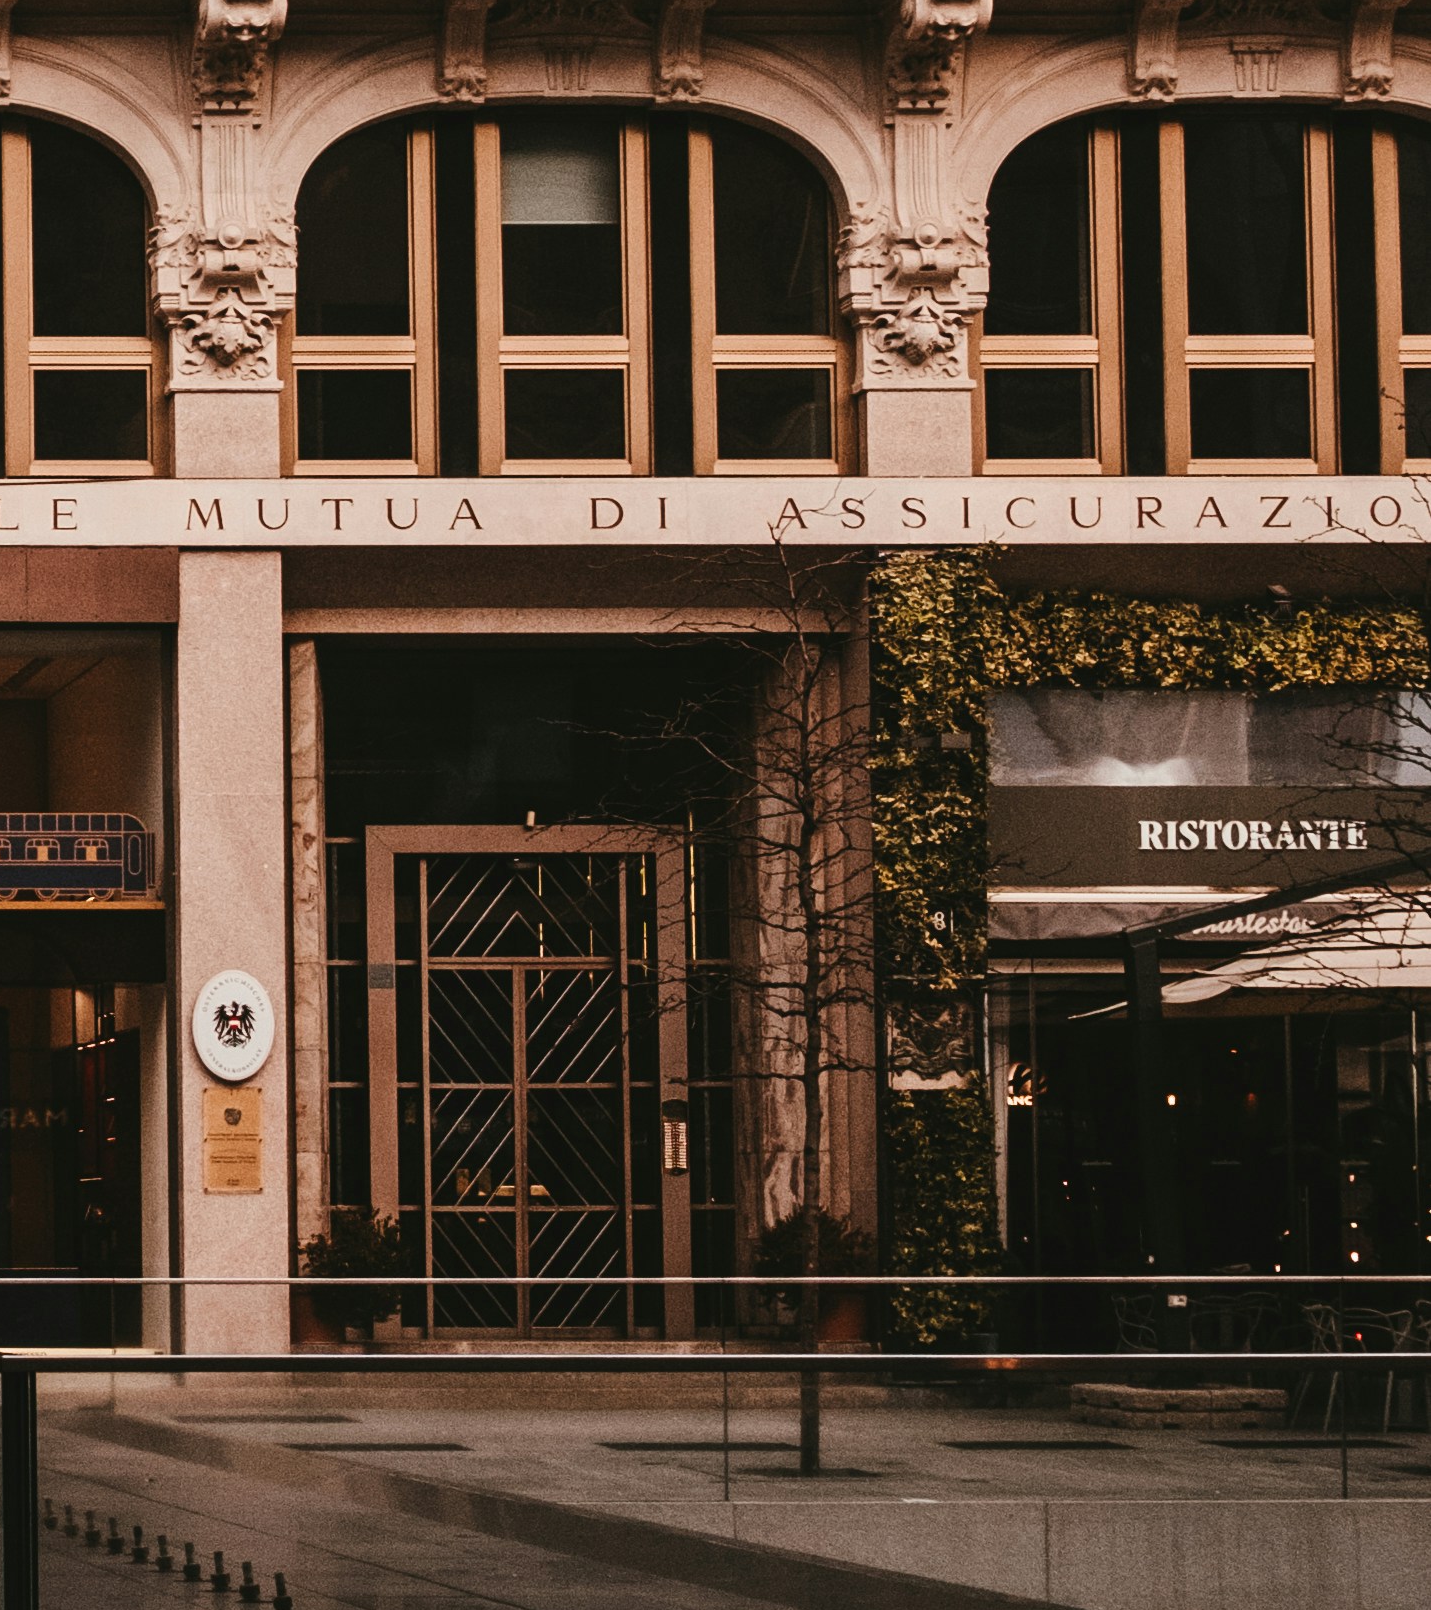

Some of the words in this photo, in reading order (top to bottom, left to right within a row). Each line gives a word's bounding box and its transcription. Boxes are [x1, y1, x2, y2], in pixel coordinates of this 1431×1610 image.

[184, 496, 484, 532] MUTUA
[590, 496, 670, 532] DI
[1137, 819, 1369, 851] RISTORANTE
